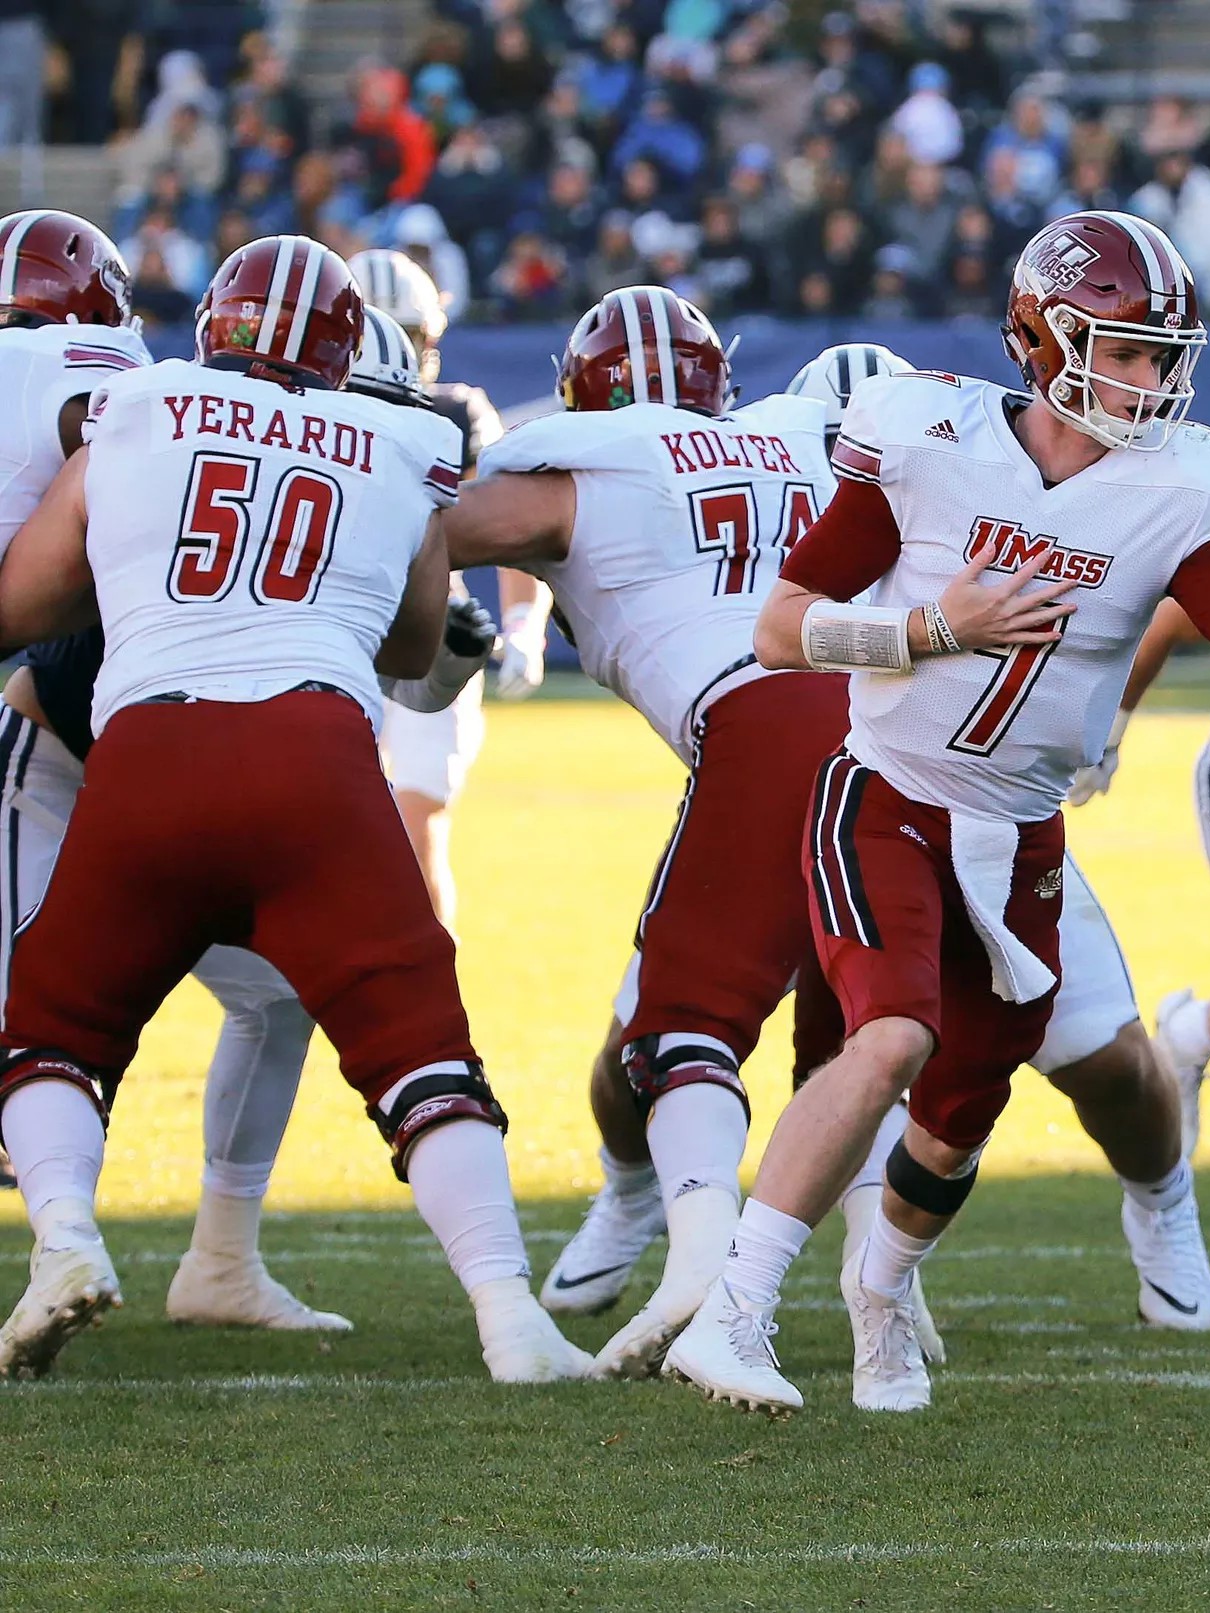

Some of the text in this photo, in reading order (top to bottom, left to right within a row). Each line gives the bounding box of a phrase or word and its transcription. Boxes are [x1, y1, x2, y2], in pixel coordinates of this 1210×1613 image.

[608, 365, 622, 383] 74
[1166, 362, 1183, 386] Ridd
[164, 395, 375, 474] YERARDI
[660, 430, 802, 474] KOLTER
[924, 429, 960, 443] adidas
[166, 450, 344, 605] 50
[945, 601, 1069, 758] 7
